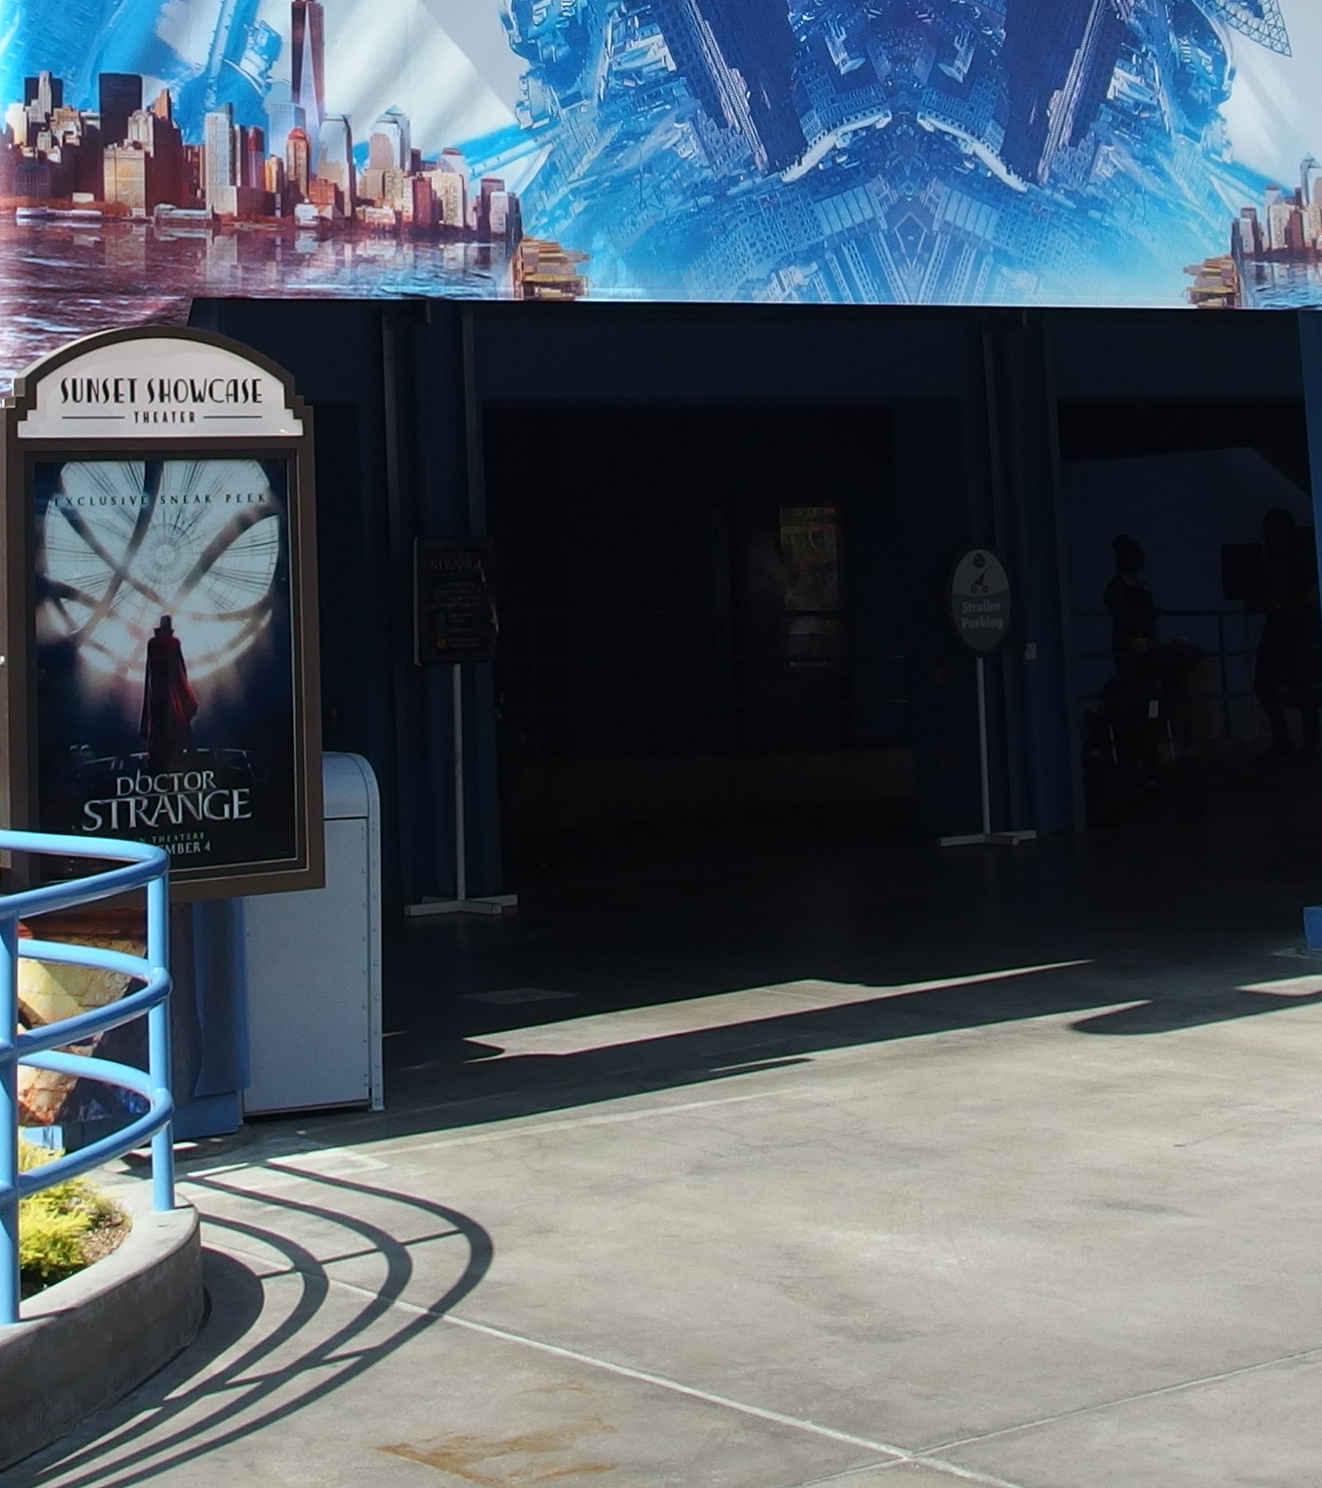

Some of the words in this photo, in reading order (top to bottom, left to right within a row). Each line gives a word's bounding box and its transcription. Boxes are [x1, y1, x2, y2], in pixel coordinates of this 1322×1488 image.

[60, 377, 138, 405] SUNSET
[146, 377, 263, 405] SHOWCASE
[134, 410, 196, 424] THEATER
[54, 494, 148, 508] EXCLUSIVE
[159, 493, 213, 505] SNEAK
[225, 492, 267, 504] PEEK
[961, 598, 1002, 614] Stroller
[961, 614, 1004, 630] Parking
[116, 769, 217, 797] DOCTOR
[81, 787, 253, 832] STRANGE
[152, 831, 205, 844] THEATERS
[204, 840, 212, 852] 4
